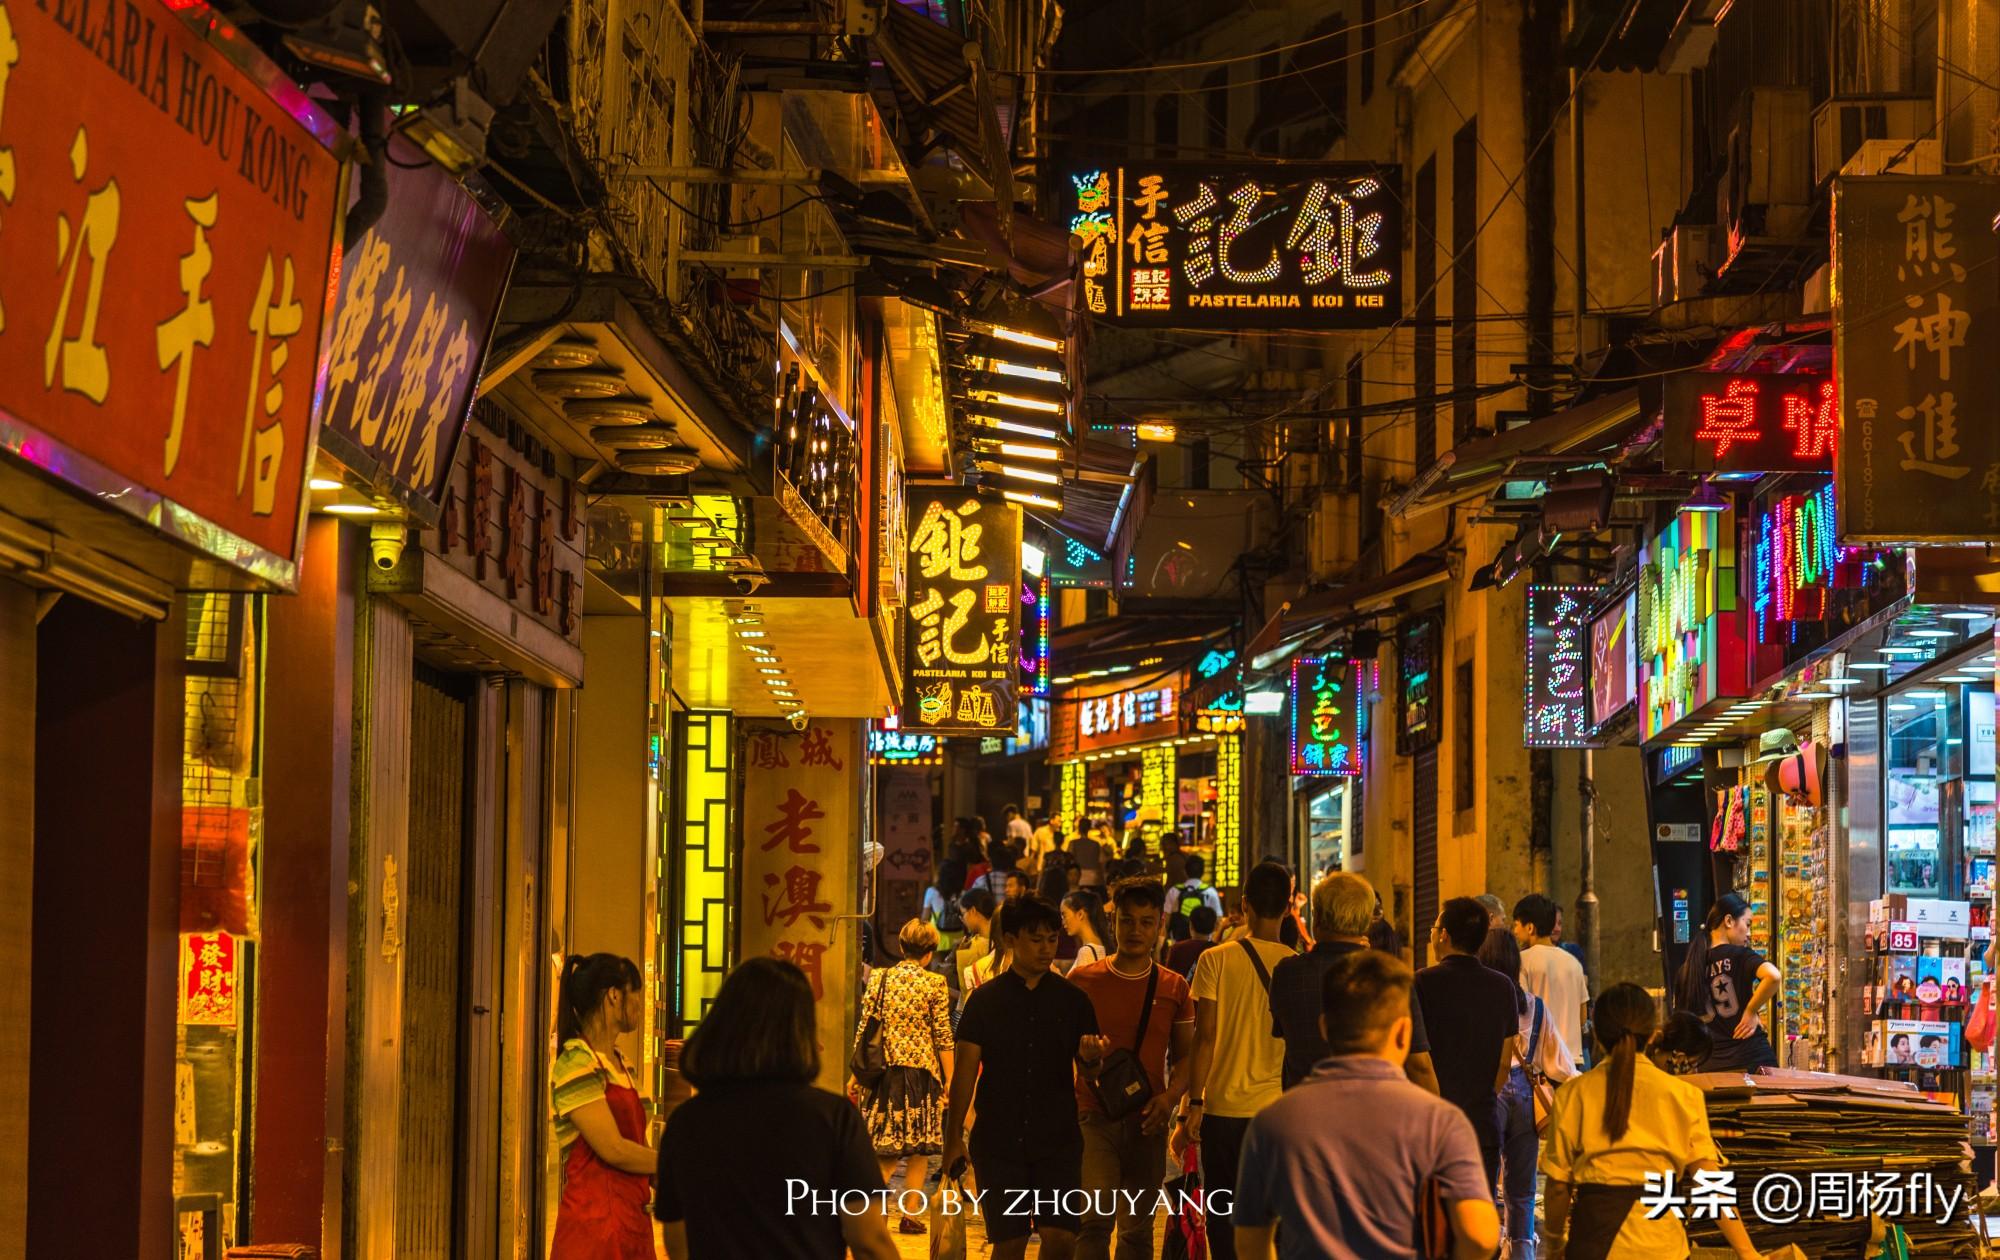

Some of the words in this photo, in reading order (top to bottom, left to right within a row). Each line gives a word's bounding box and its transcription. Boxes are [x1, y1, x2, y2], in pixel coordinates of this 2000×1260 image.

[36, 0, 169, 114] ELARIA
[175, 50, 240, 162] HOU
[239, 104, 312, 222] KONG
[1127, 174, 1169, 264] 手信
[1188, 294, 1302, 309] PASTELARIA
[1312, 294, 1344, 309] KOI
[1355, 294, 1385, 309] KEI
[1892, 192, 1973, 480] 熊神進
[909, 499, 990, 668] 鉅記
[989, 617, 1010, 664] 手信
[912, 669, 967, 678] PASTELARIA
[971, 669, 987, 679] KOI
[991, 669, 1006, 679] KEI
[751, 727, 843, 771] 鳳城
[1301, 743, 1350, 769] 餅家
[760, 787, 833, 1003] 老澳門
[1894, 933, 1913, 948] 85
